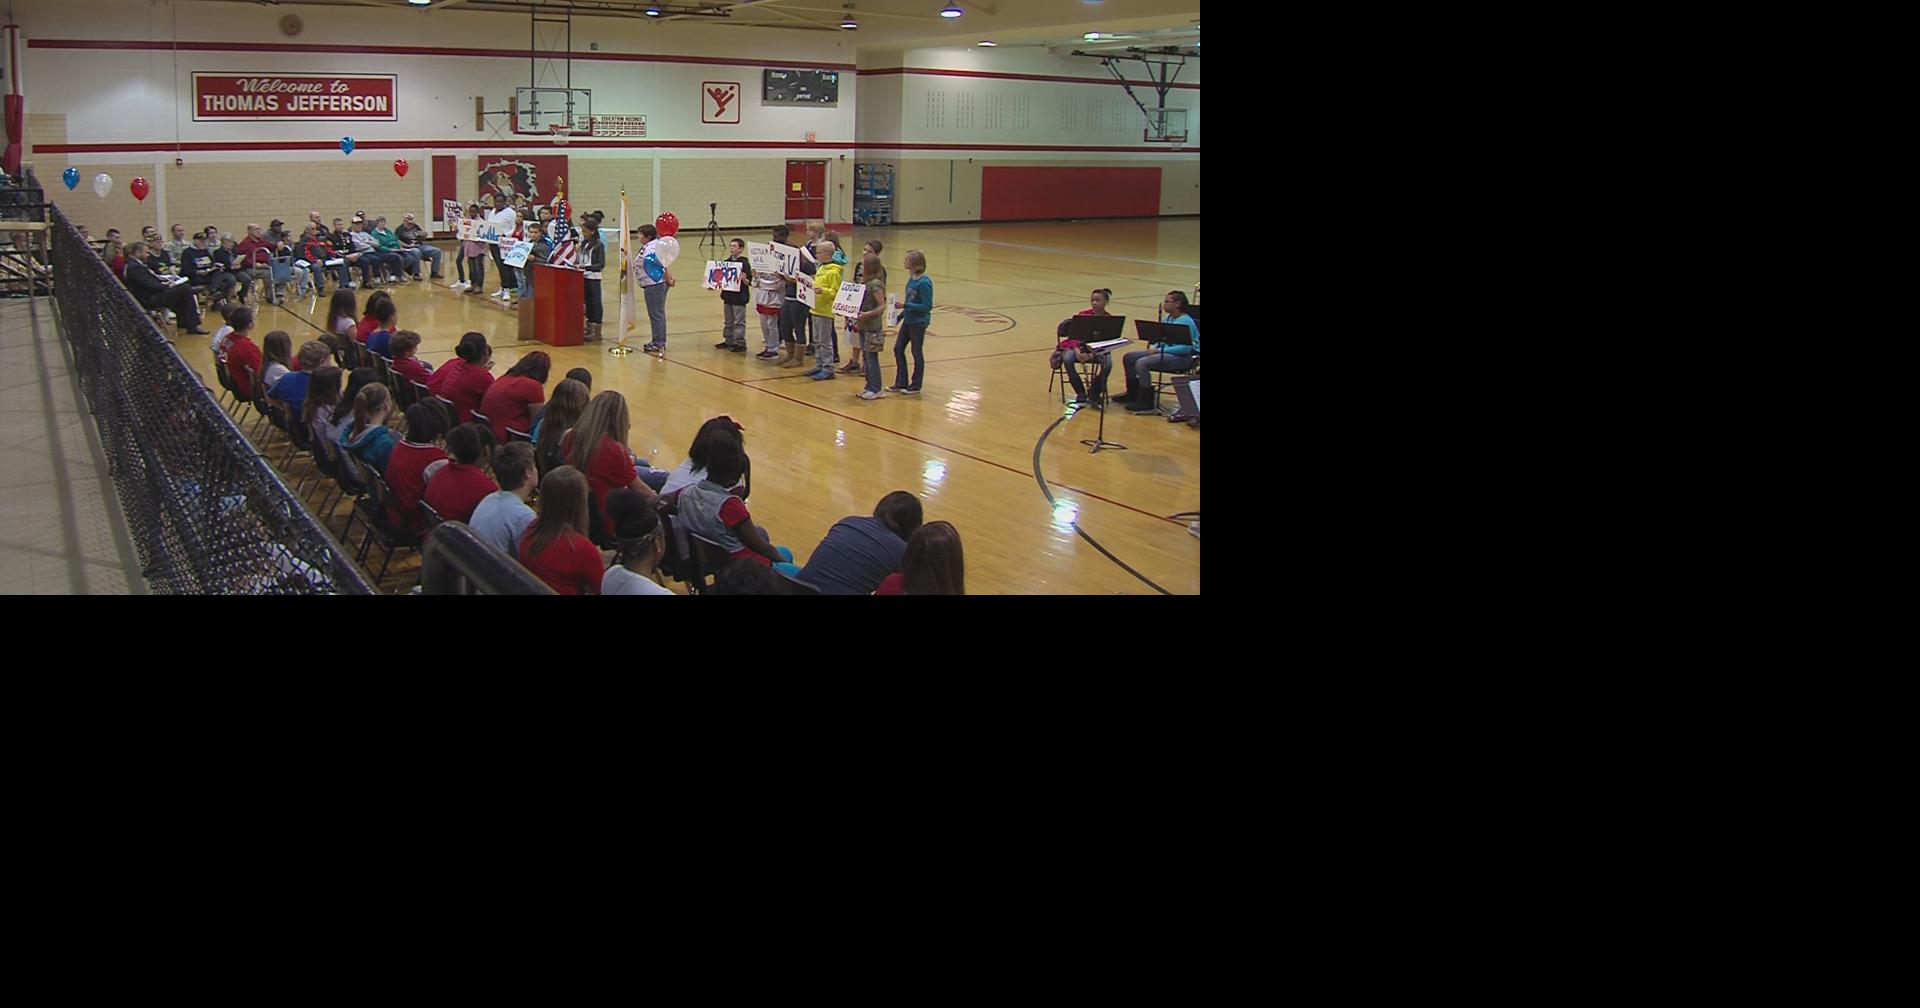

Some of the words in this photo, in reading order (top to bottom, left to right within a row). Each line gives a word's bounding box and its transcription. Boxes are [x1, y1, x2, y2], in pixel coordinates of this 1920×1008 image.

[236, 78, 323, 93] Welcome
[330, 80, 349, 93] to
[203, 95, 279, 111] THOMAS
[287, 95, 387, 112] JEFFERSON
